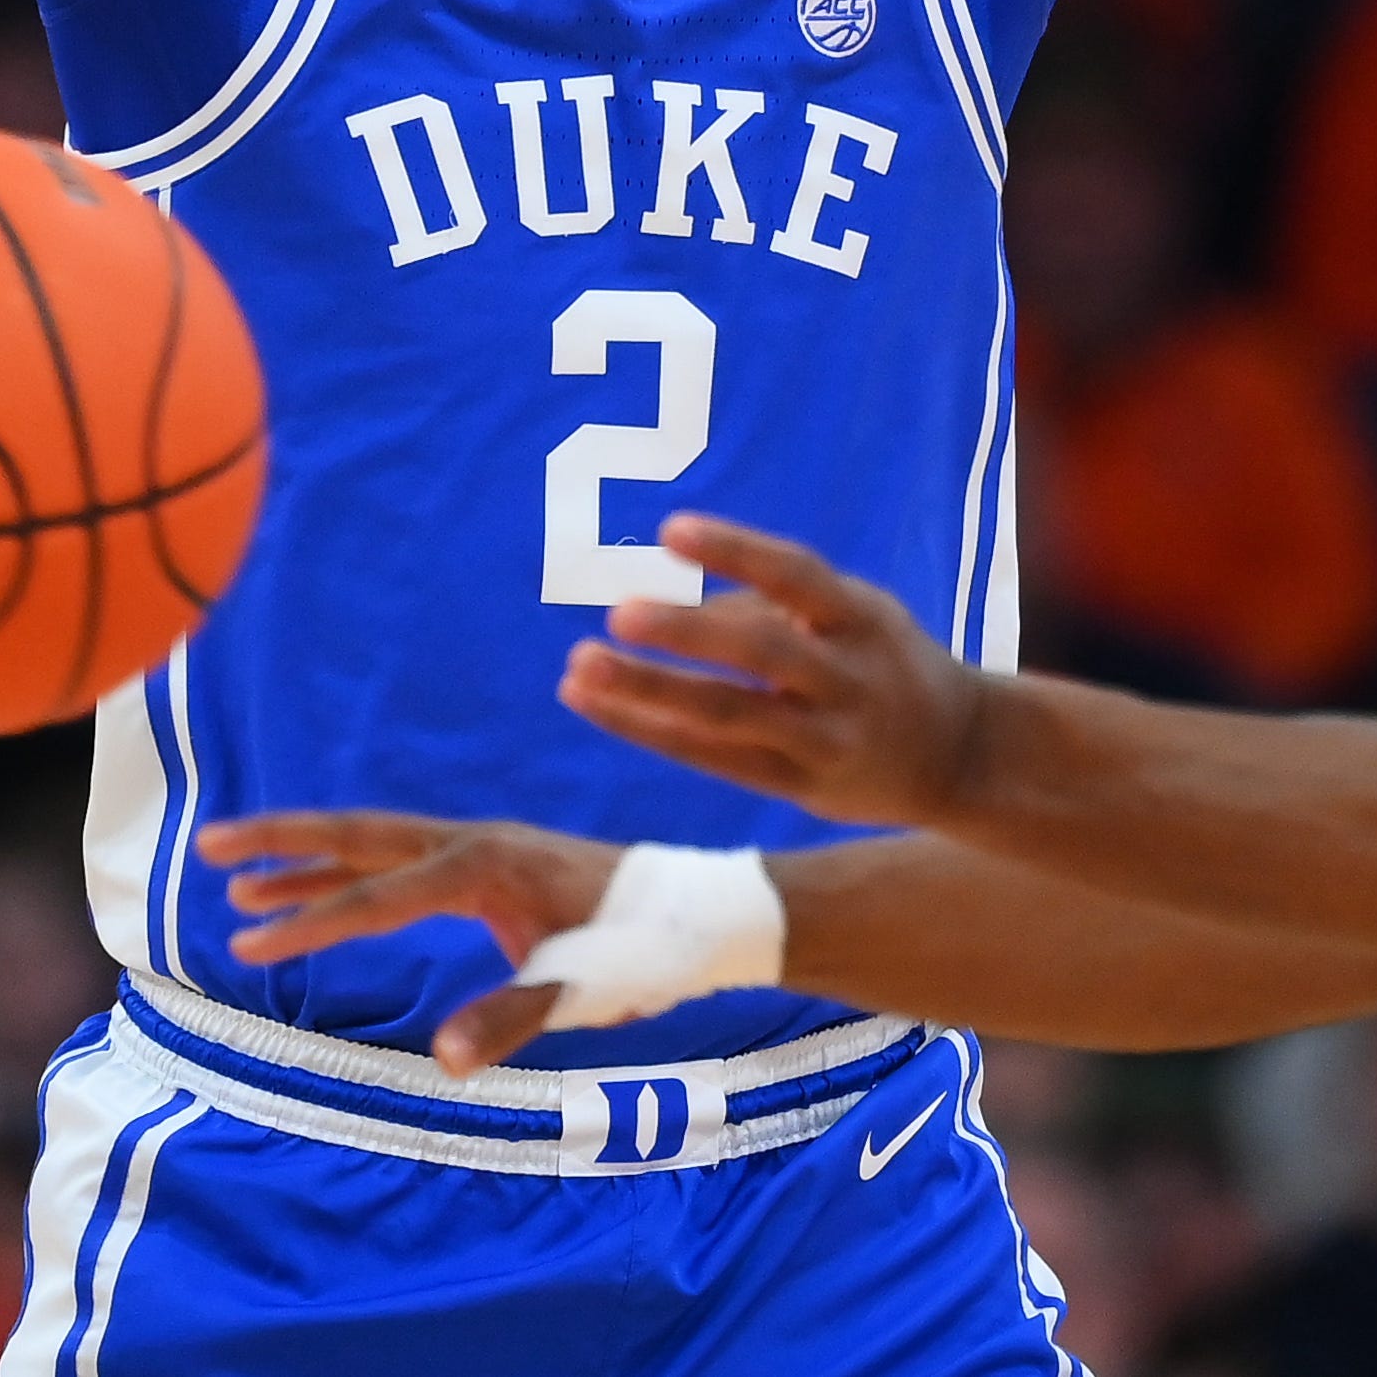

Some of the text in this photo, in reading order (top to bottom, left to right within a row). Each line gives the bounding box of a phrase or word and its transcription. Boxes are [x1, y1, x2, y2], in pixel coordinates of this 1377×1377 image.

[345, 74, 899, 279] DUKE
[540, 290, 717, 607] 2
[595, 1078, 689, 1163] D
